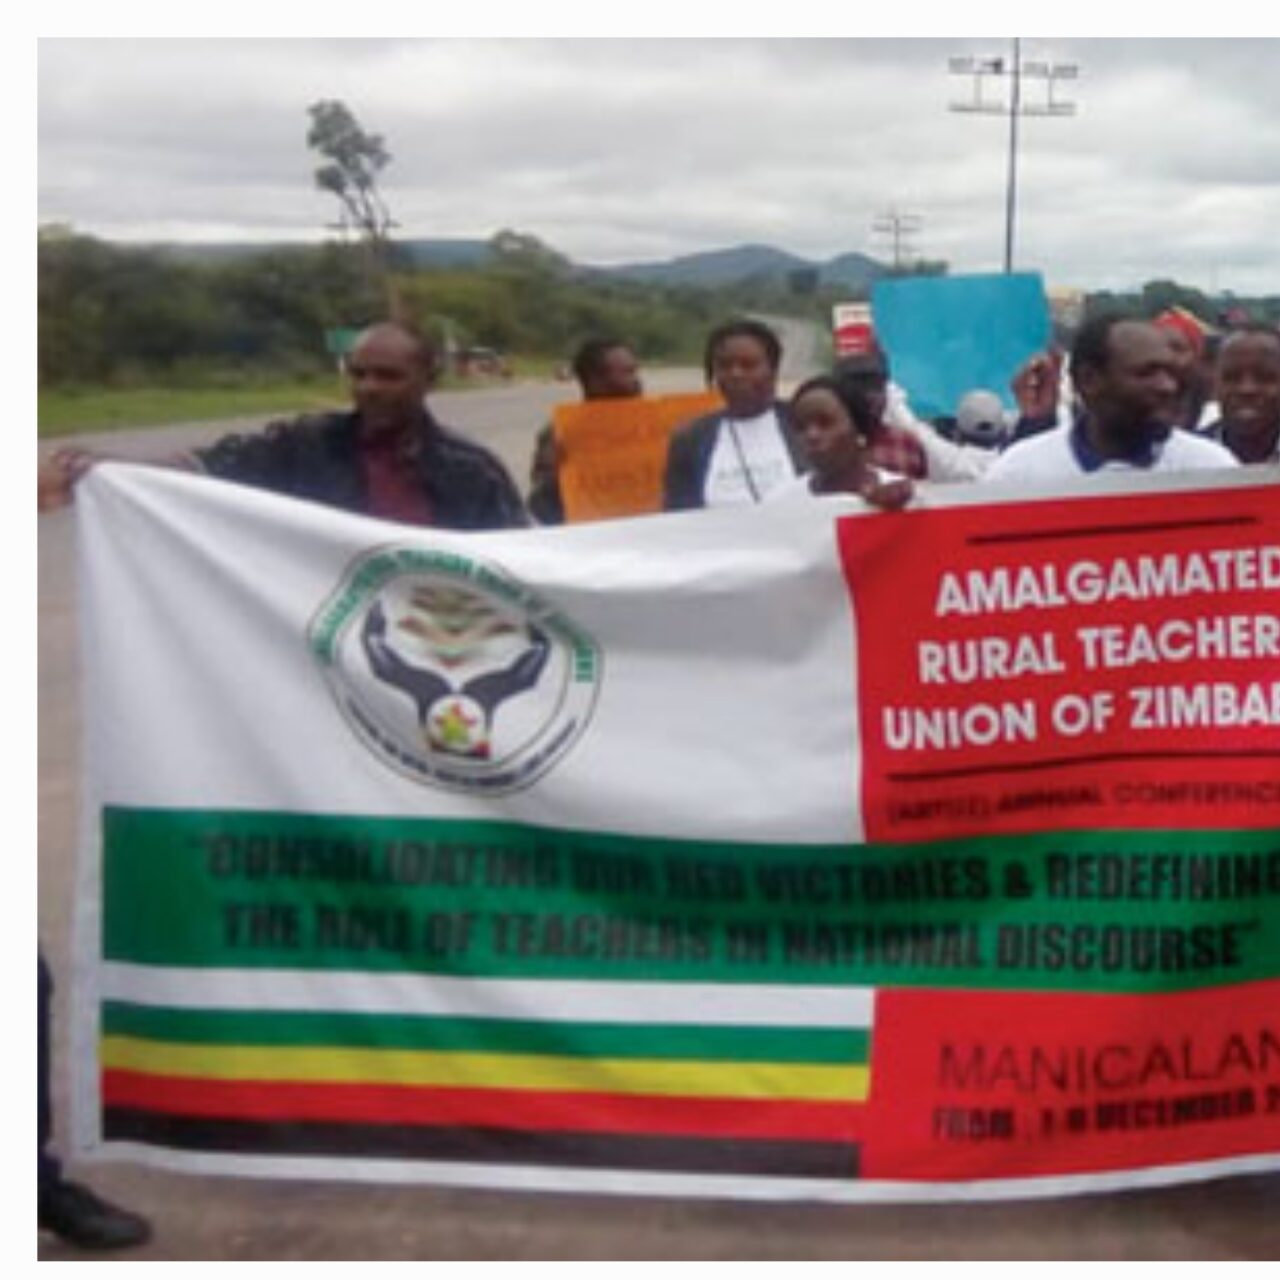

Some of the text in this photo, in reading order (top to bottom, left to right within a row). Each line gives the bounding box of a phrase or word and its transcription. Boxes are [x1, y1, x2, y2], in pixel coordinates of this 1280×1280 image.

[917, 631, 1065, 684] RURAL
[882, 702, 1037, 751] UNION
[1052, 693, 1115, 736] OF
[570, 844, 656, 894] OUR
[665, 852, 747, 901] RED
[757, 854, 991, 905] VICTORIES
[1003, 859, 1034, 898] &
[222, 902, 307, 951] THE
[425, 913, 477, 959] OF
[490, 913, 713, 965] TEACHERS
[725, 922, 769, 966] IN
[782, 919, 986, 968] NATIONAL
[932, 1105, 1015, 1142] FROM
[1095, 1090, 1255, 1134] DECEMBER
